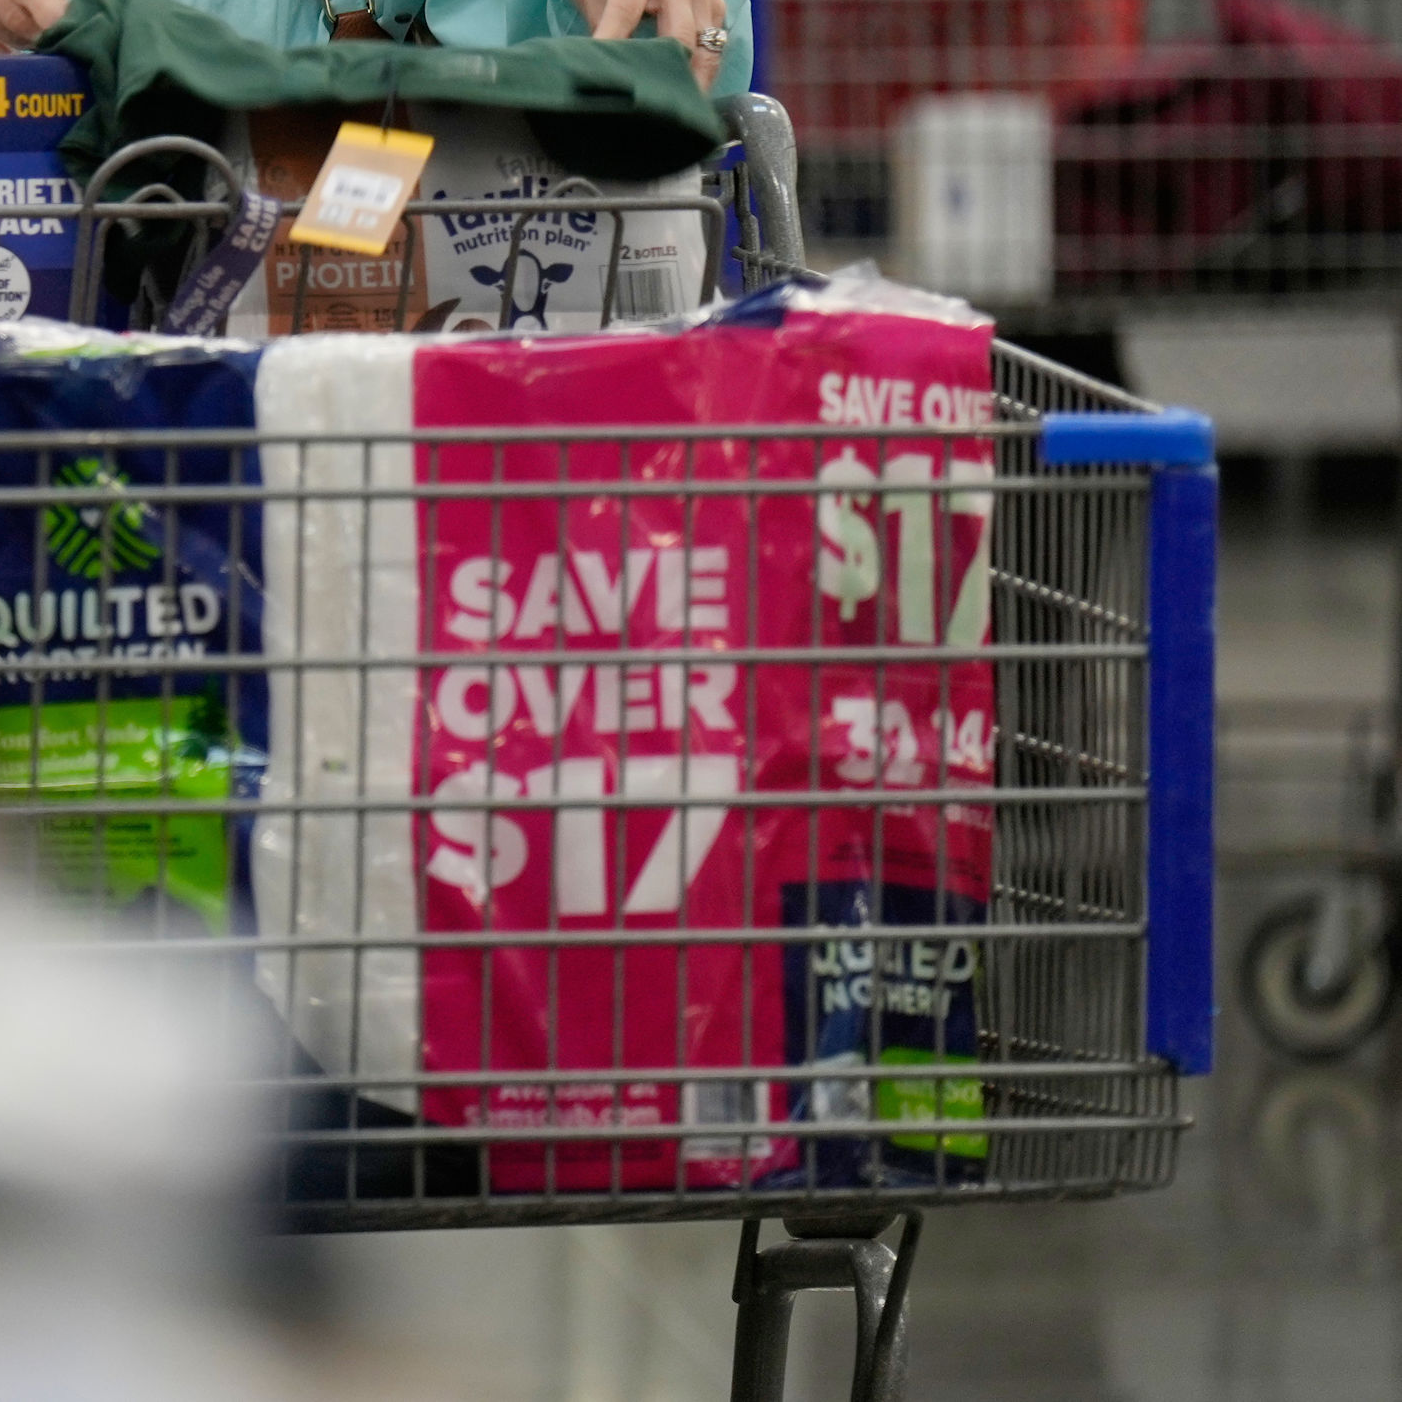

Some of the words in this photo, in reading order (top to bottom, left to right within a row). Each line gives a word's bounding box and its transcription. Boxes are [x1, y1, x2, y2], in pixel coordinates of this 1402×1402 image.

[15, 94, 84, 118] COUNT
[250, 199, 279, 252] CLUB
[545, 228, 585, 252] plan
[634, 246, 678, 259] BOTTLES
[819, 372, 915, 430] SAVE
[819, 445, 994, 649] $17
[447, 546, 729, 643] SAVE
[437, 662, 738, 742] OVER
[427, 754, 740, 916] $17
